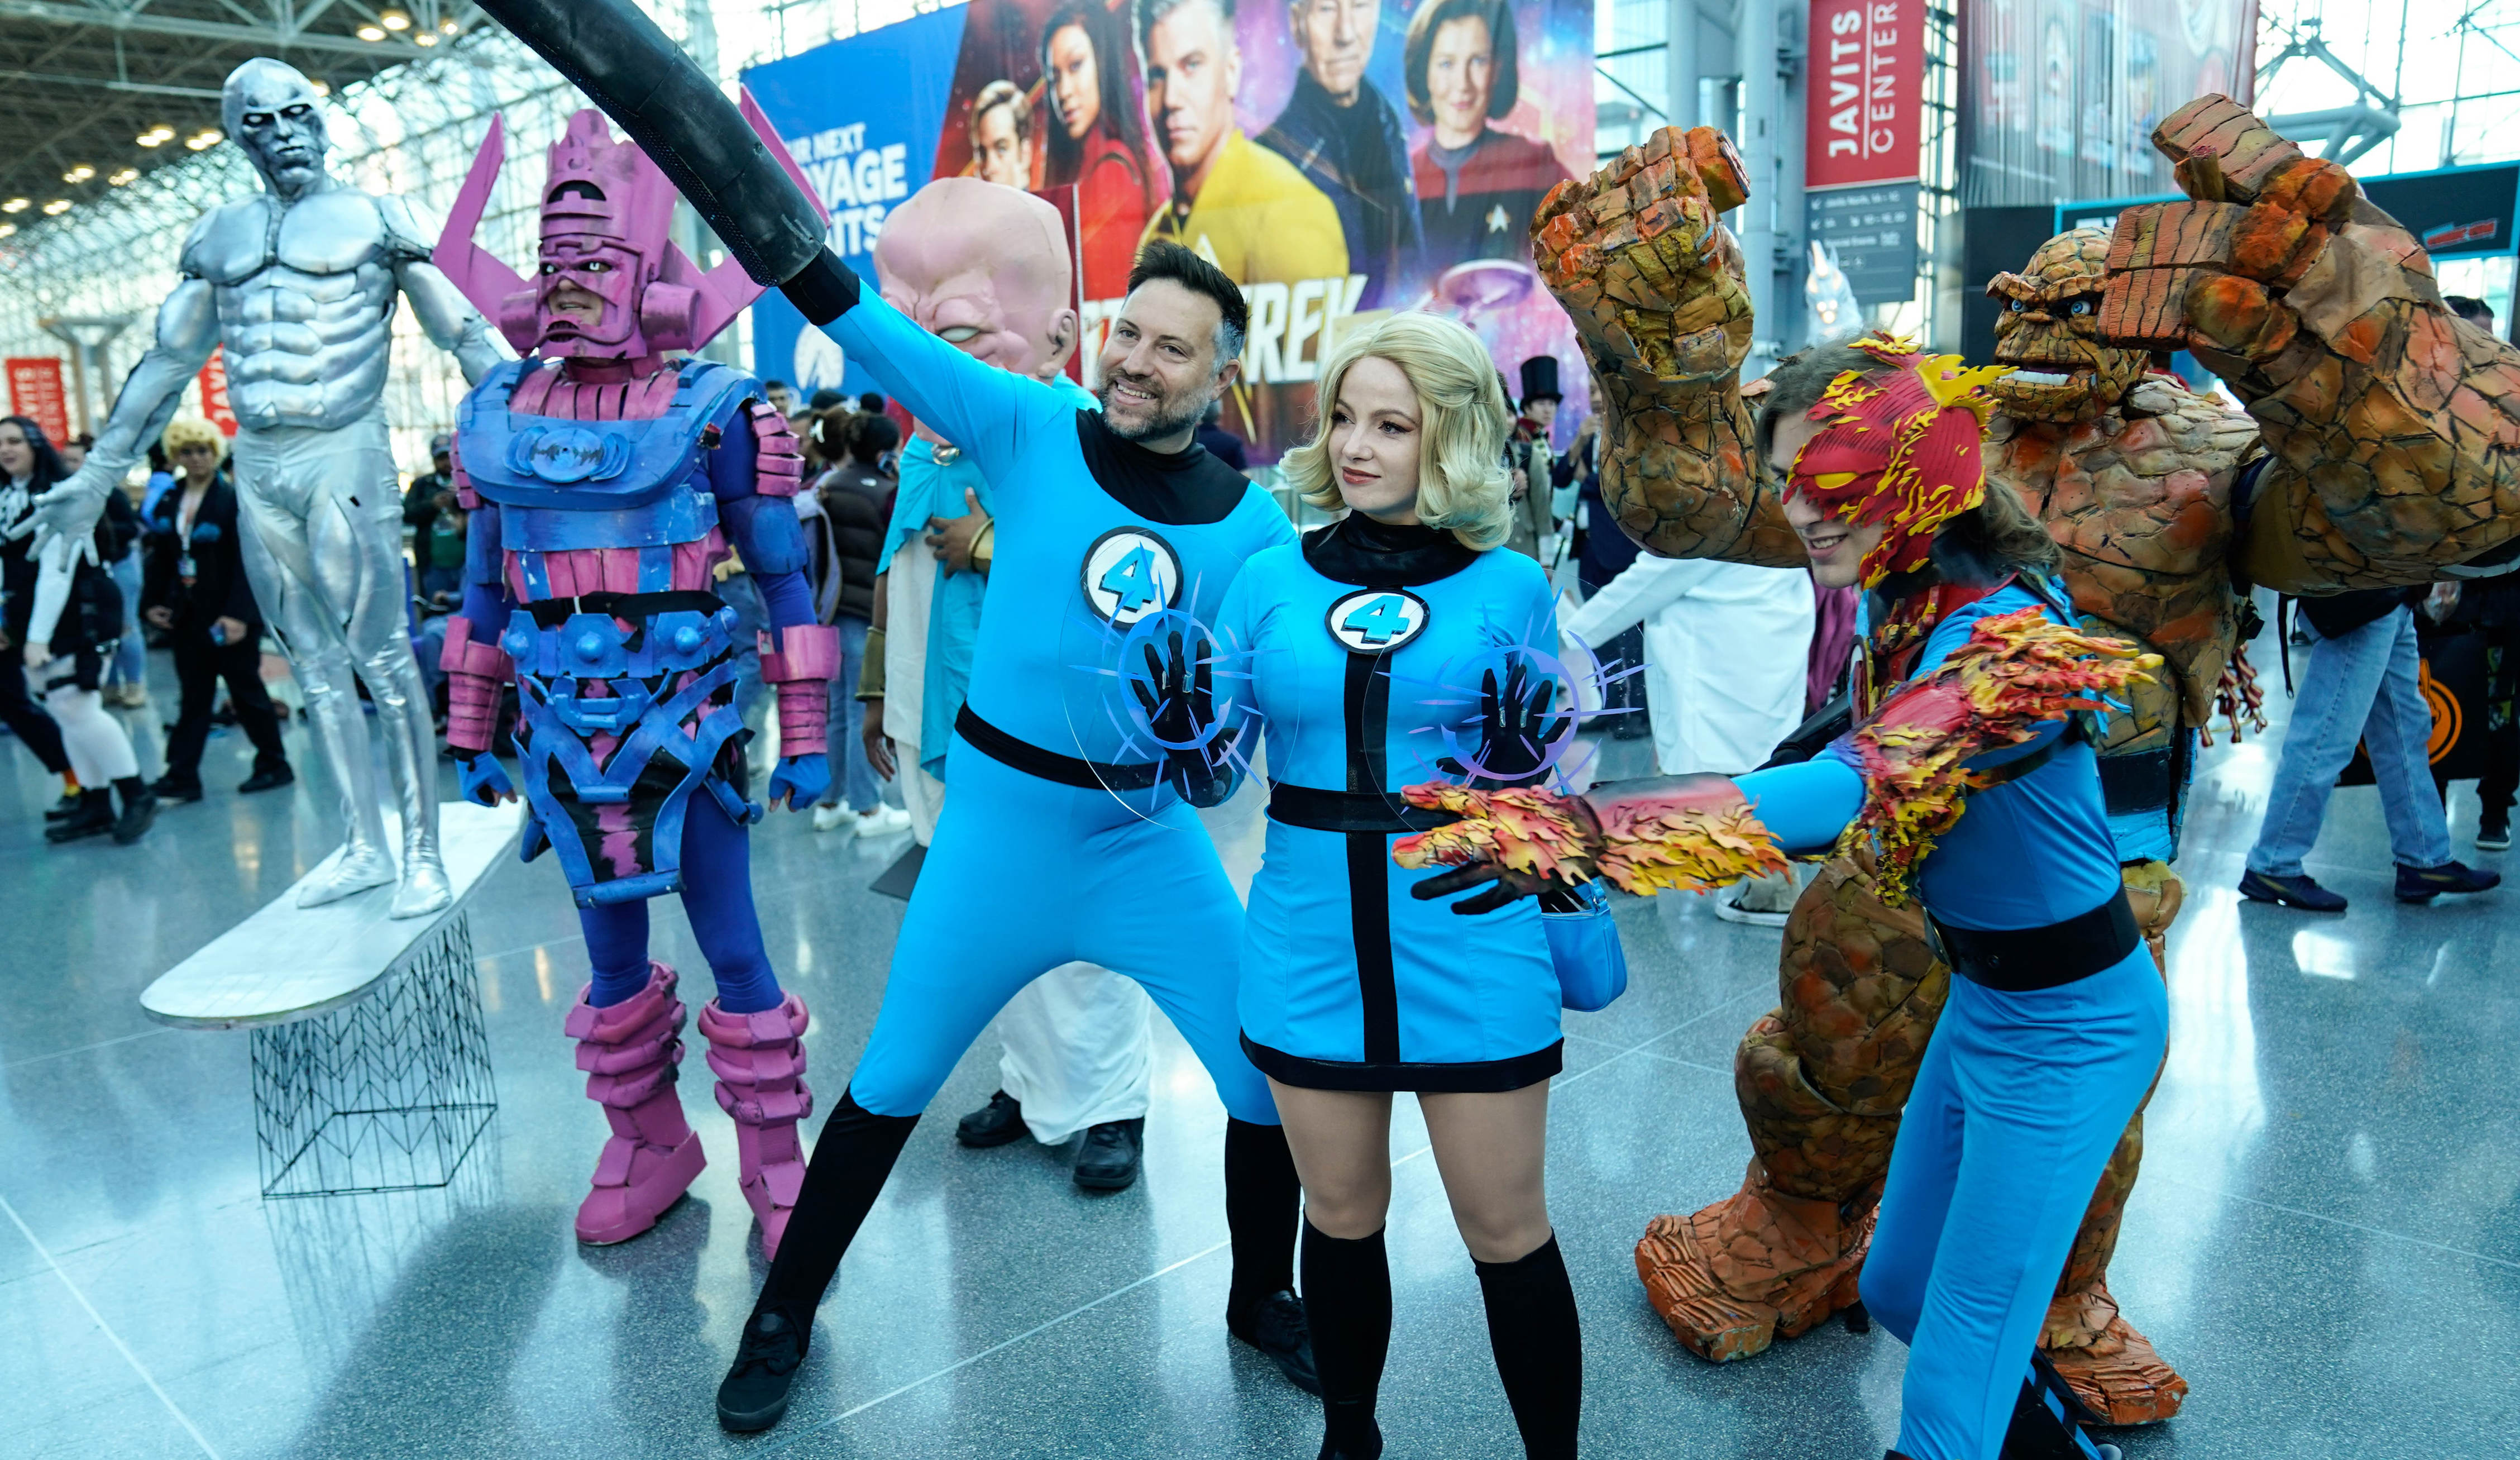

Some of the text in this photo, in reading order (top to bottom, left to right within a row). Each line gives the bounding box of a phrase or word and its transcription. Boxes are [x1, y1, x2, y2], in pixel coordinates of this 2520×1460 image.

[1828, 9, 1862, 158] JAVITS
[1869, 1, 1899, 154] CENTER
[812, 122, 867, 161] NEXT
[801, 142, 908, 211] YAGE
[825, 204, 886, 257] ITS
[1098, 546, 1158, 613] 4
[1341, 595, 1410, 645] 4
